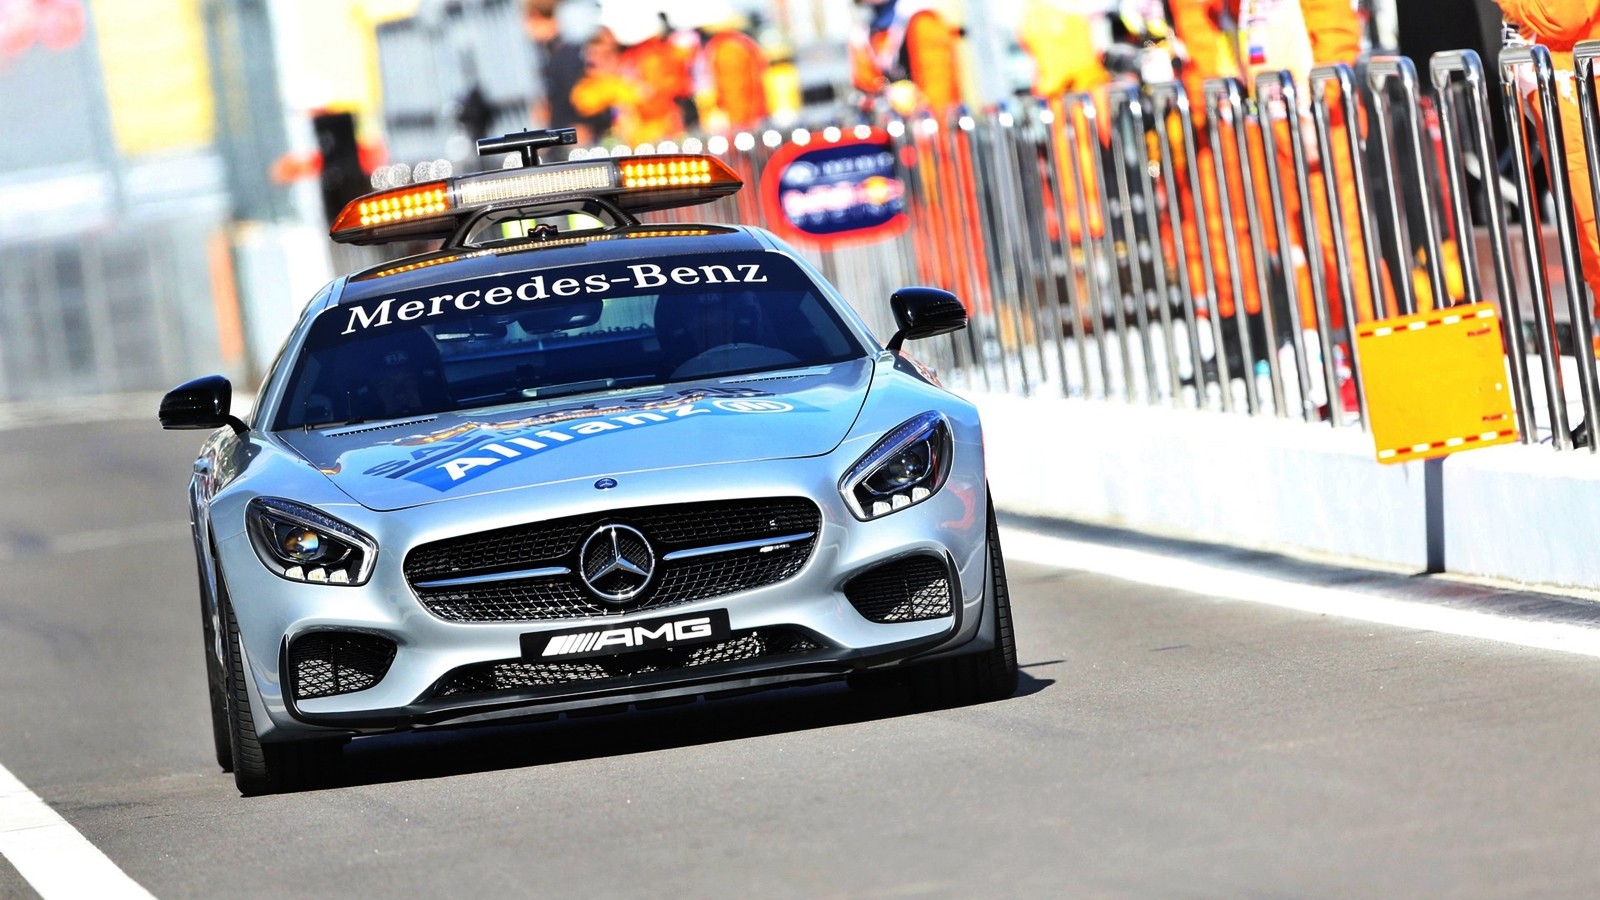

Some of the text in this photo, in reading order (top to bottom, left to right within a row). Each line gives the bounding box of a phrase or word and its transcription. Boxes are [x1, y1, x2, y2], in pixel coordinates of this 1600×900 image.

[340, 263, 768, 335] Mercedes-Benz
[436, 404, 711, 481] Allianz
[595, 617, 712, 652] AMG
